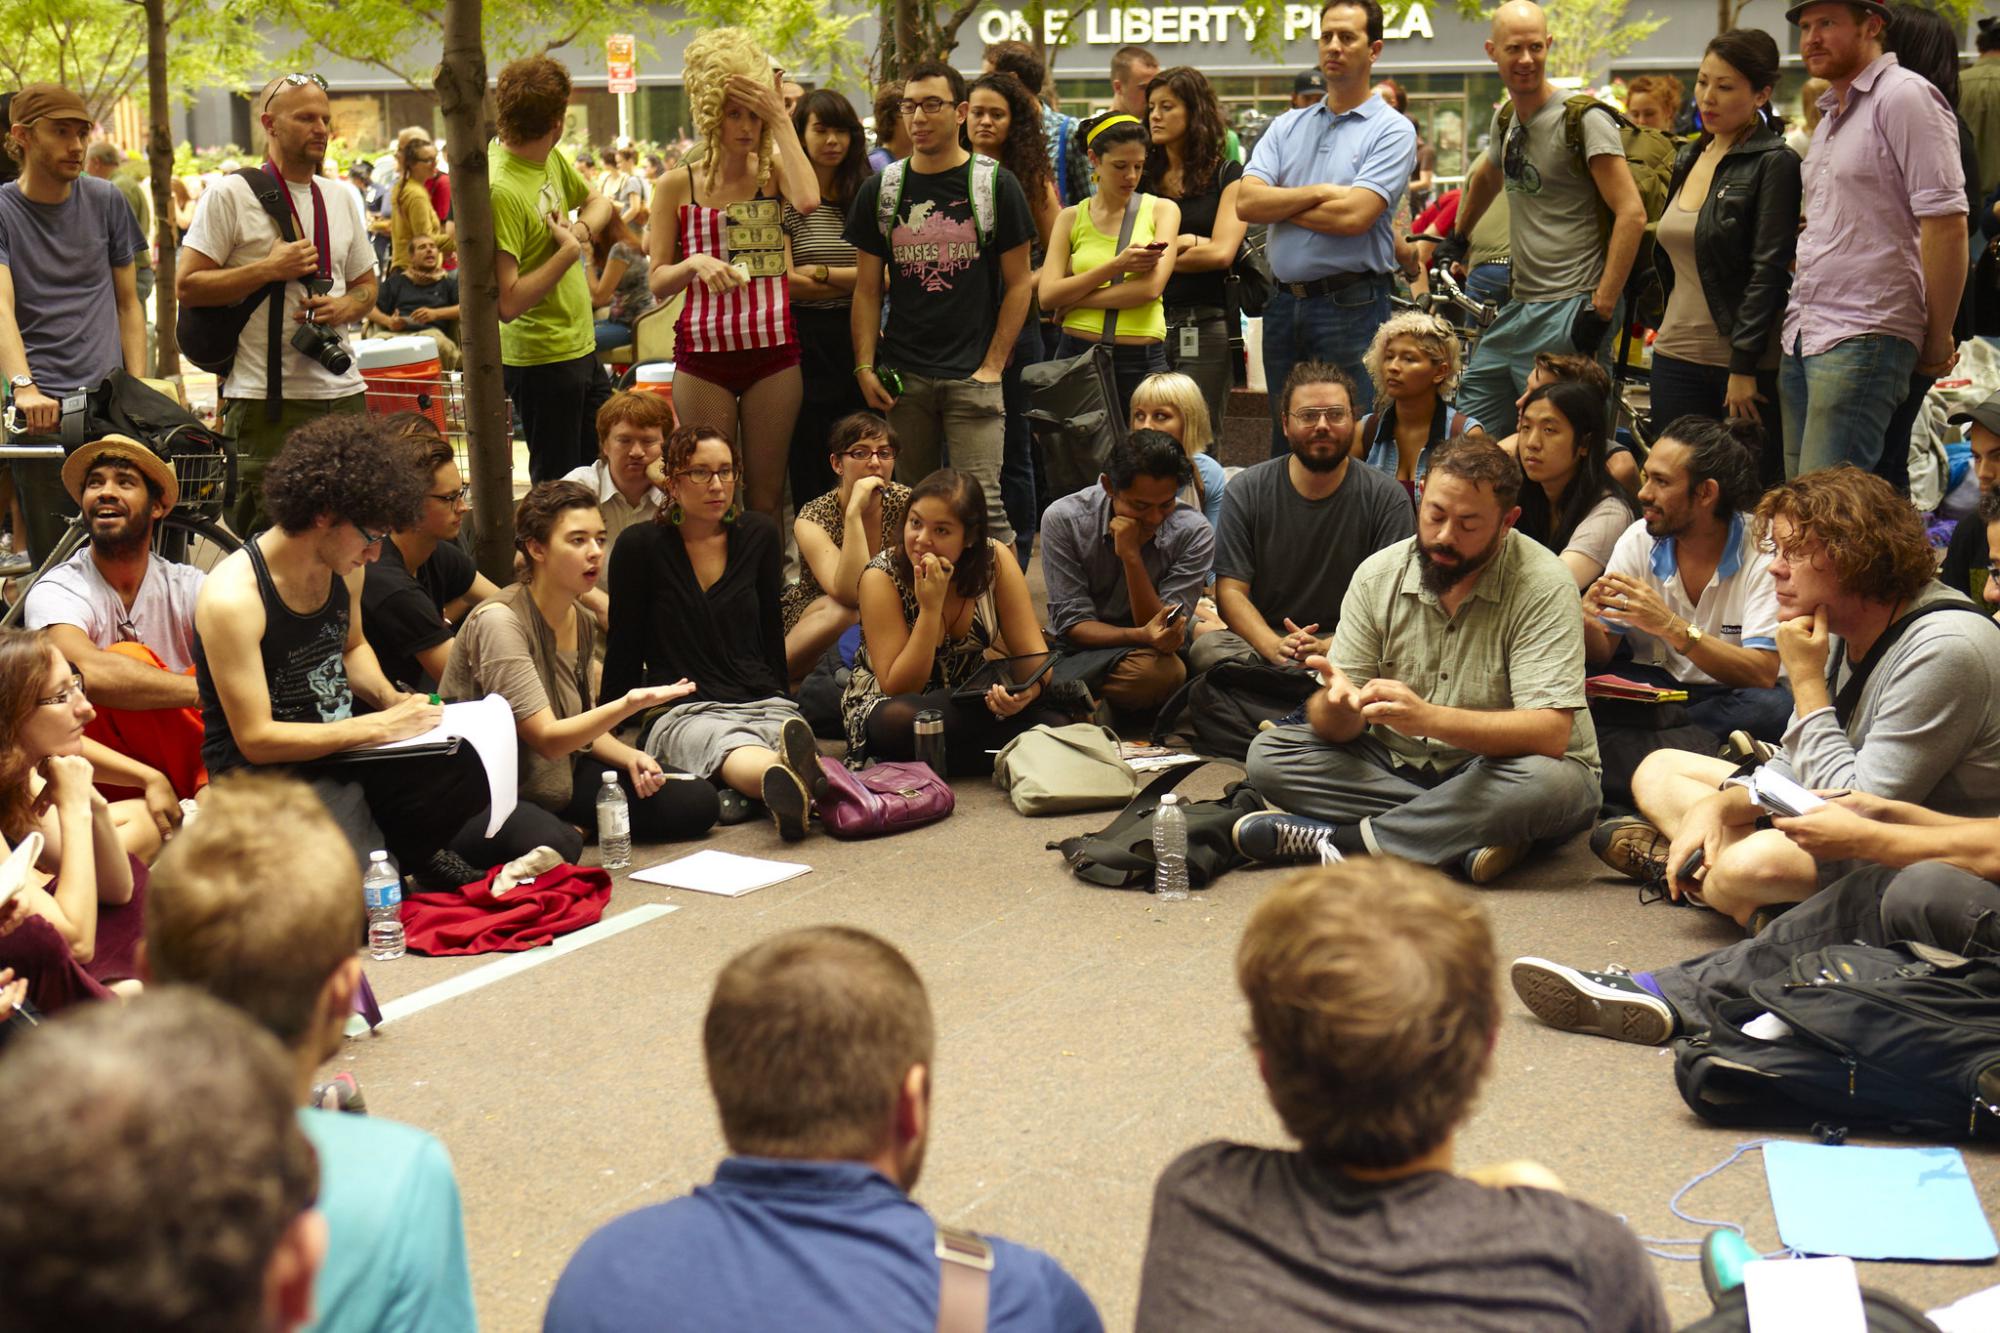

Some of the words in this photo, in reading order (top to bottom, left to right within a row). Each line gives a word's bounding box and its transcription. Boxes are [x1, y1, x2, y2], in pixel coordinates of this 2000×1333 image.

[978, 9, 1069, 45] ONE
[1086, 6, 1264, 43] LIBERTY
[1284, 2, 1434, 41] PLZA
[893, 242, 940, 262] SENSES
[948, 241, 980, 261] FAIL
